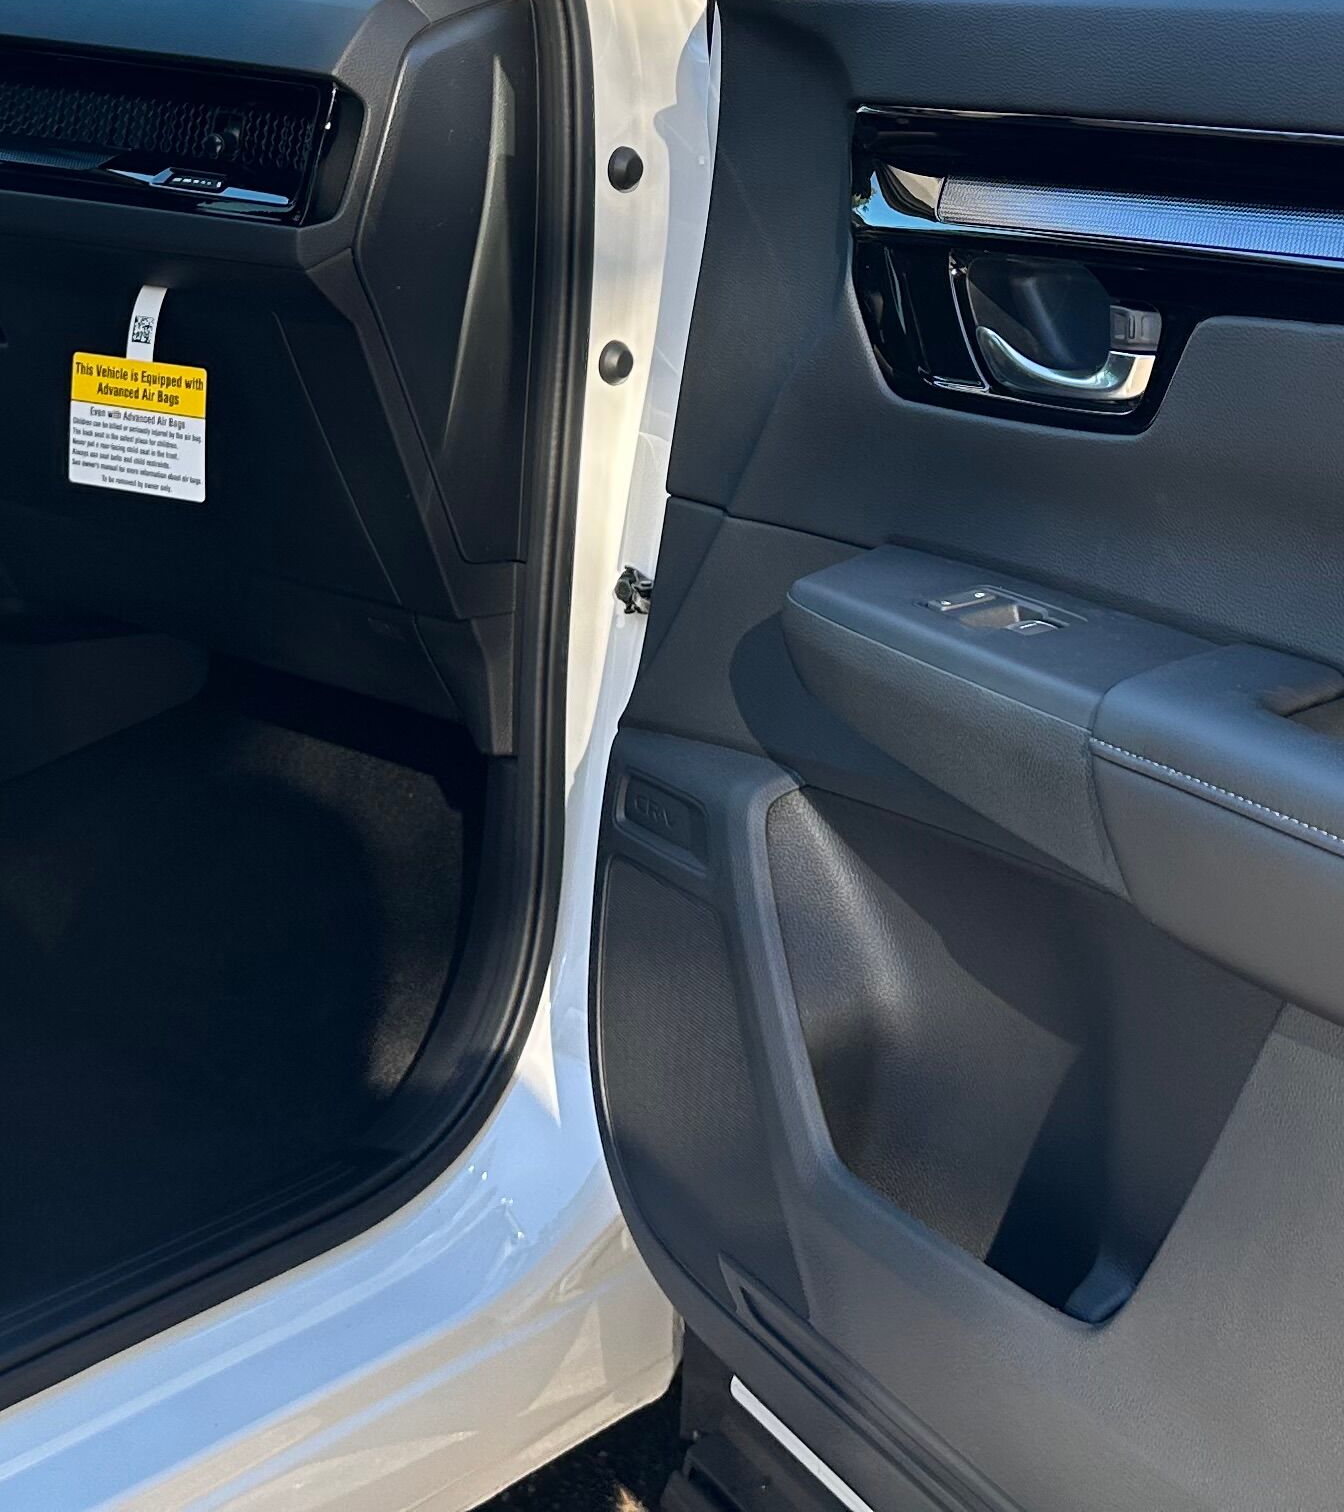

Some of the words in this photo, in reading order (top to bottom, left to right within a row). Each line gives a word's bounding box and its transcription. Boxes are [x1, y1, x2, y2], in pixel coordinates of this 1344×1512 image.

[75, 361, 94, 376] This
[96, 364, 129, 381] Vehicle
[130, 369, 139, 382] is
[141, 370, 183, 389] Equipped
[185, 377, 204, 391] with
[97, 382, 140, 400] Advanced
[142, 387, 155, 402] Air
[157, 390, 180, 407] Bags
[122, 410, 156, 425] Advanced
[156, 414, 167, 426] Air
[168, 417, 186, 431] Bags
